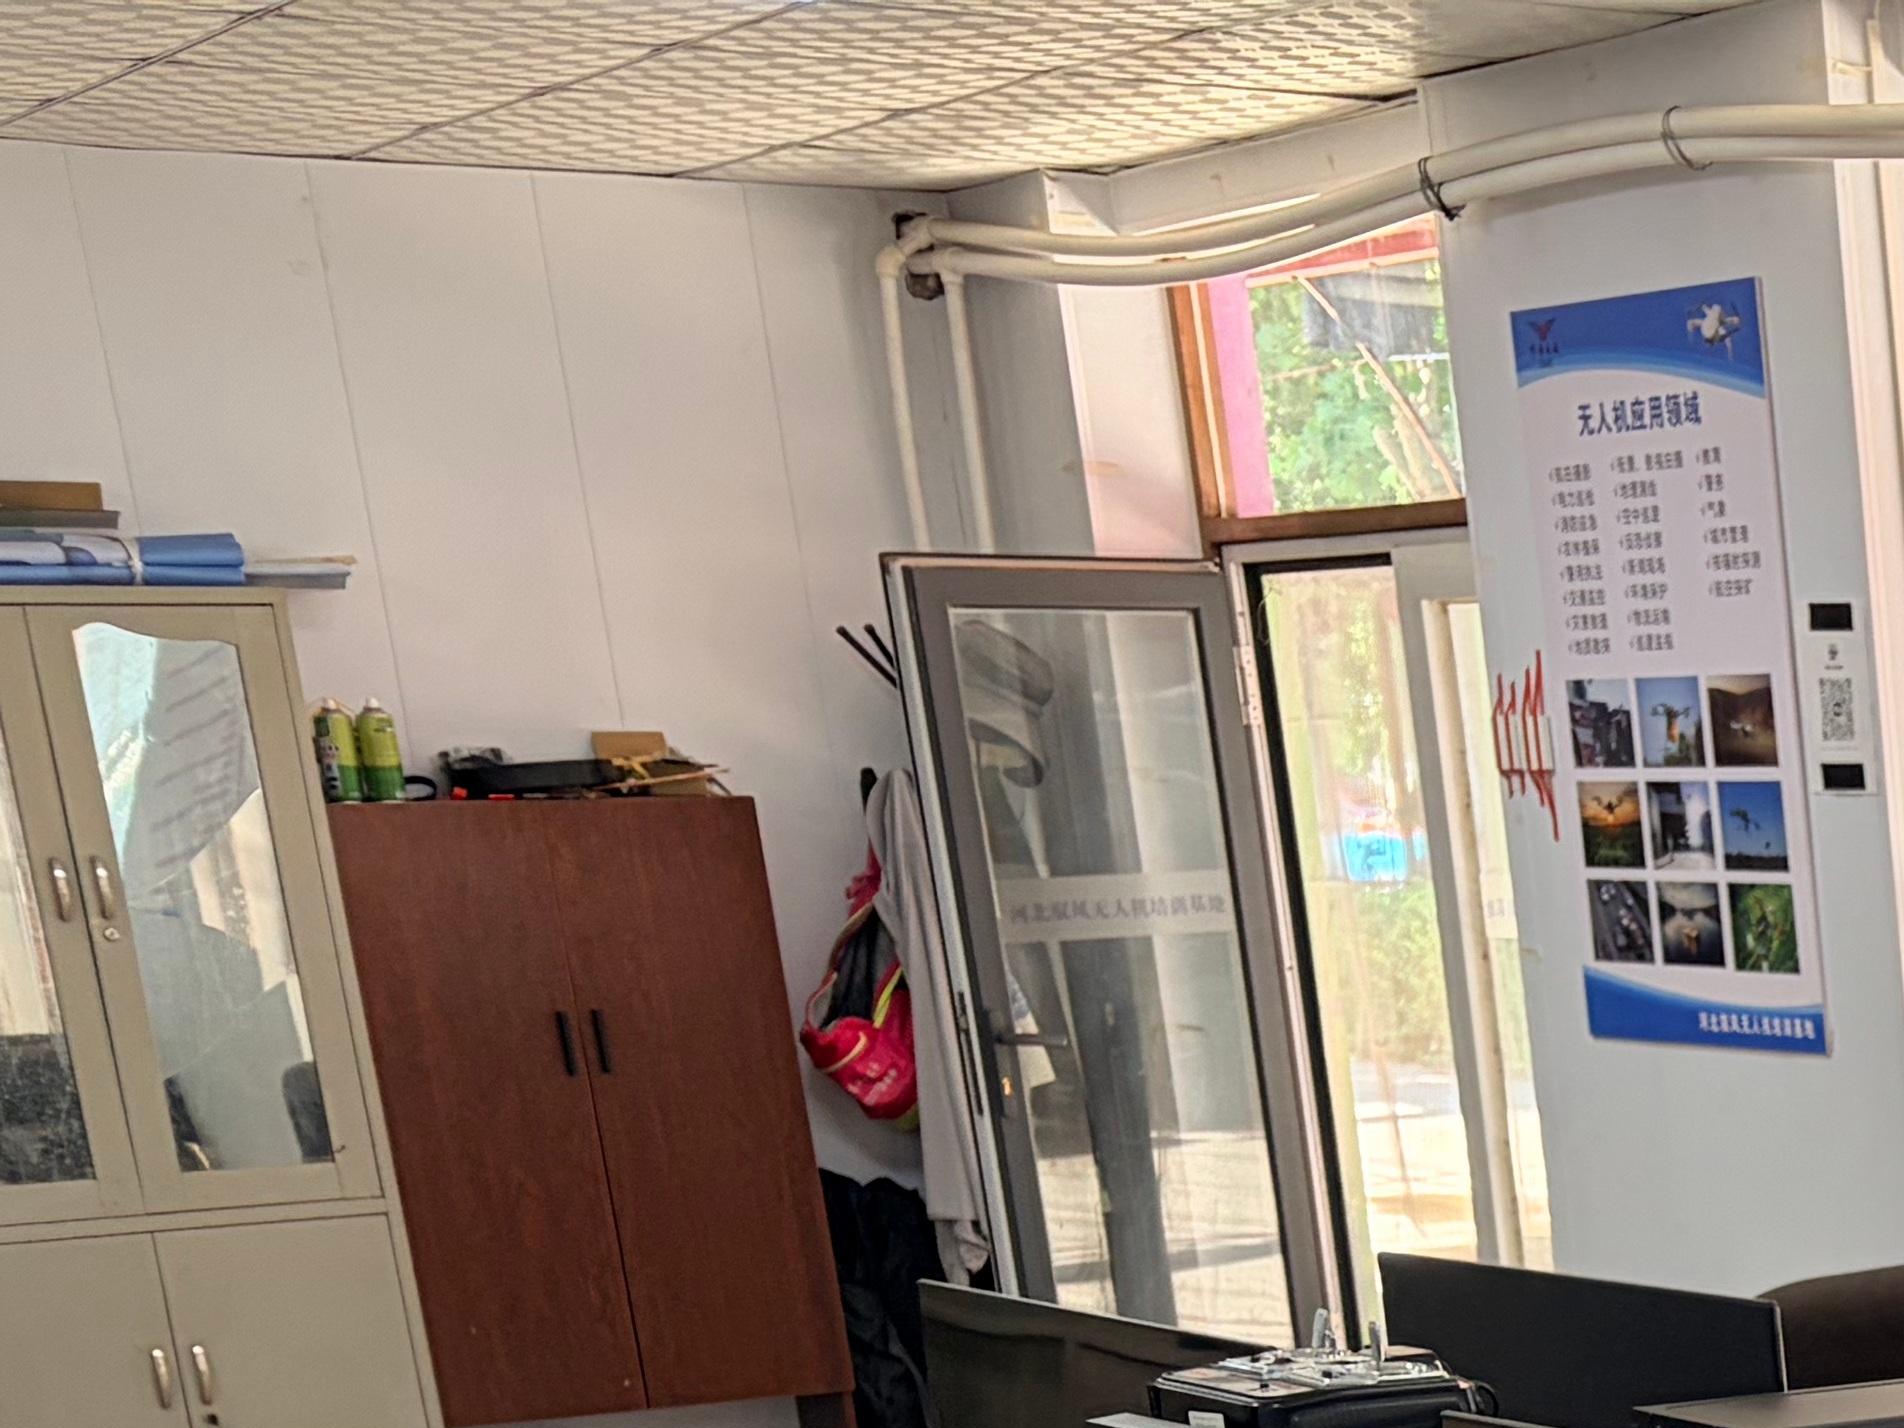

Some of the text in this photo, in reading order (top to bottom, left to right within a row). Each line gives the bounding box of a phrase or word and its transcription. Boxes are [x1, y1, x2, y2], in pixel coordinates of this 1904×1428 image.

[1577, 390, 1703, 437] 无人机应用领域
